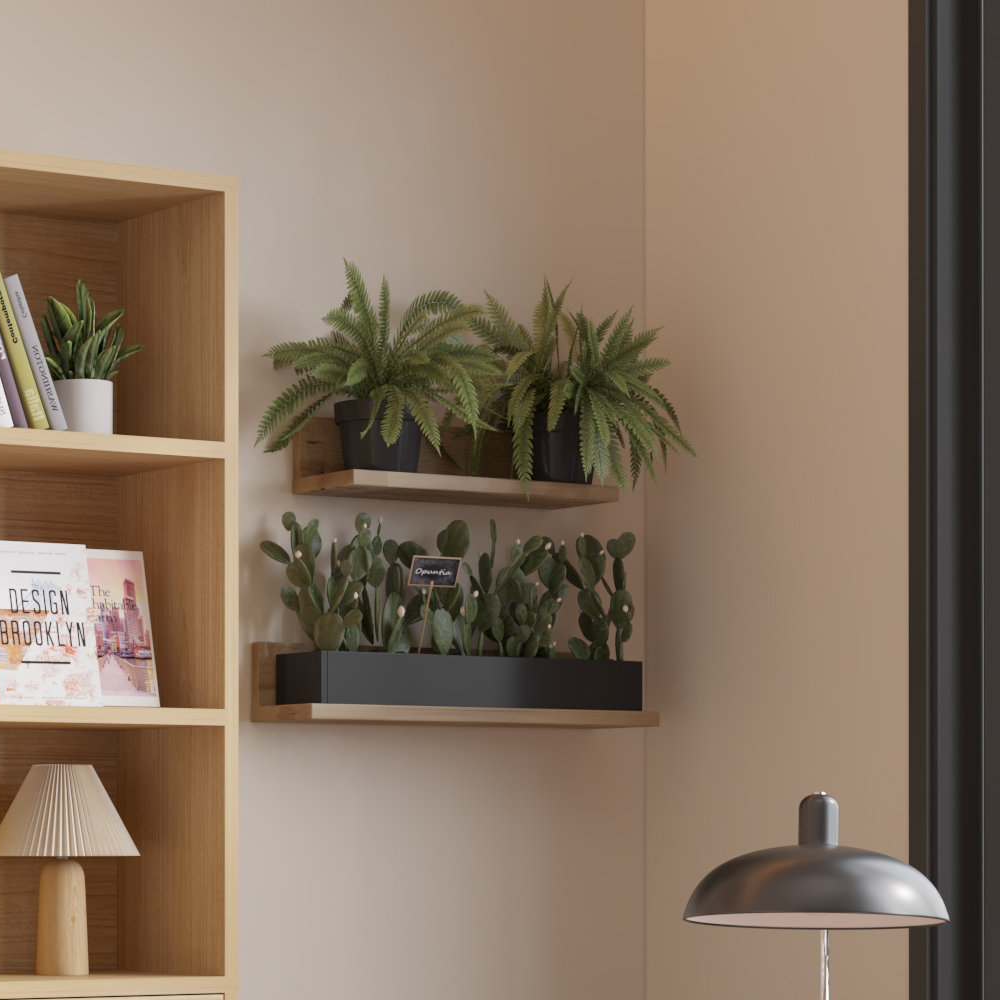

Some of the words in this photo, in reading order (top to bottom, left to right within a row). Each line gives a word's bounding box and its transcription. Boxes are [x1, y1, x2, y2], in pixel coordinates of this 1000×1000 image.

[415, 567, 453, 576] Opuntia
[90, 585, 110, 597] The
[8, 588, 69, 615] DESIGN
[0, 619, 86, 647] BROOKLYN
